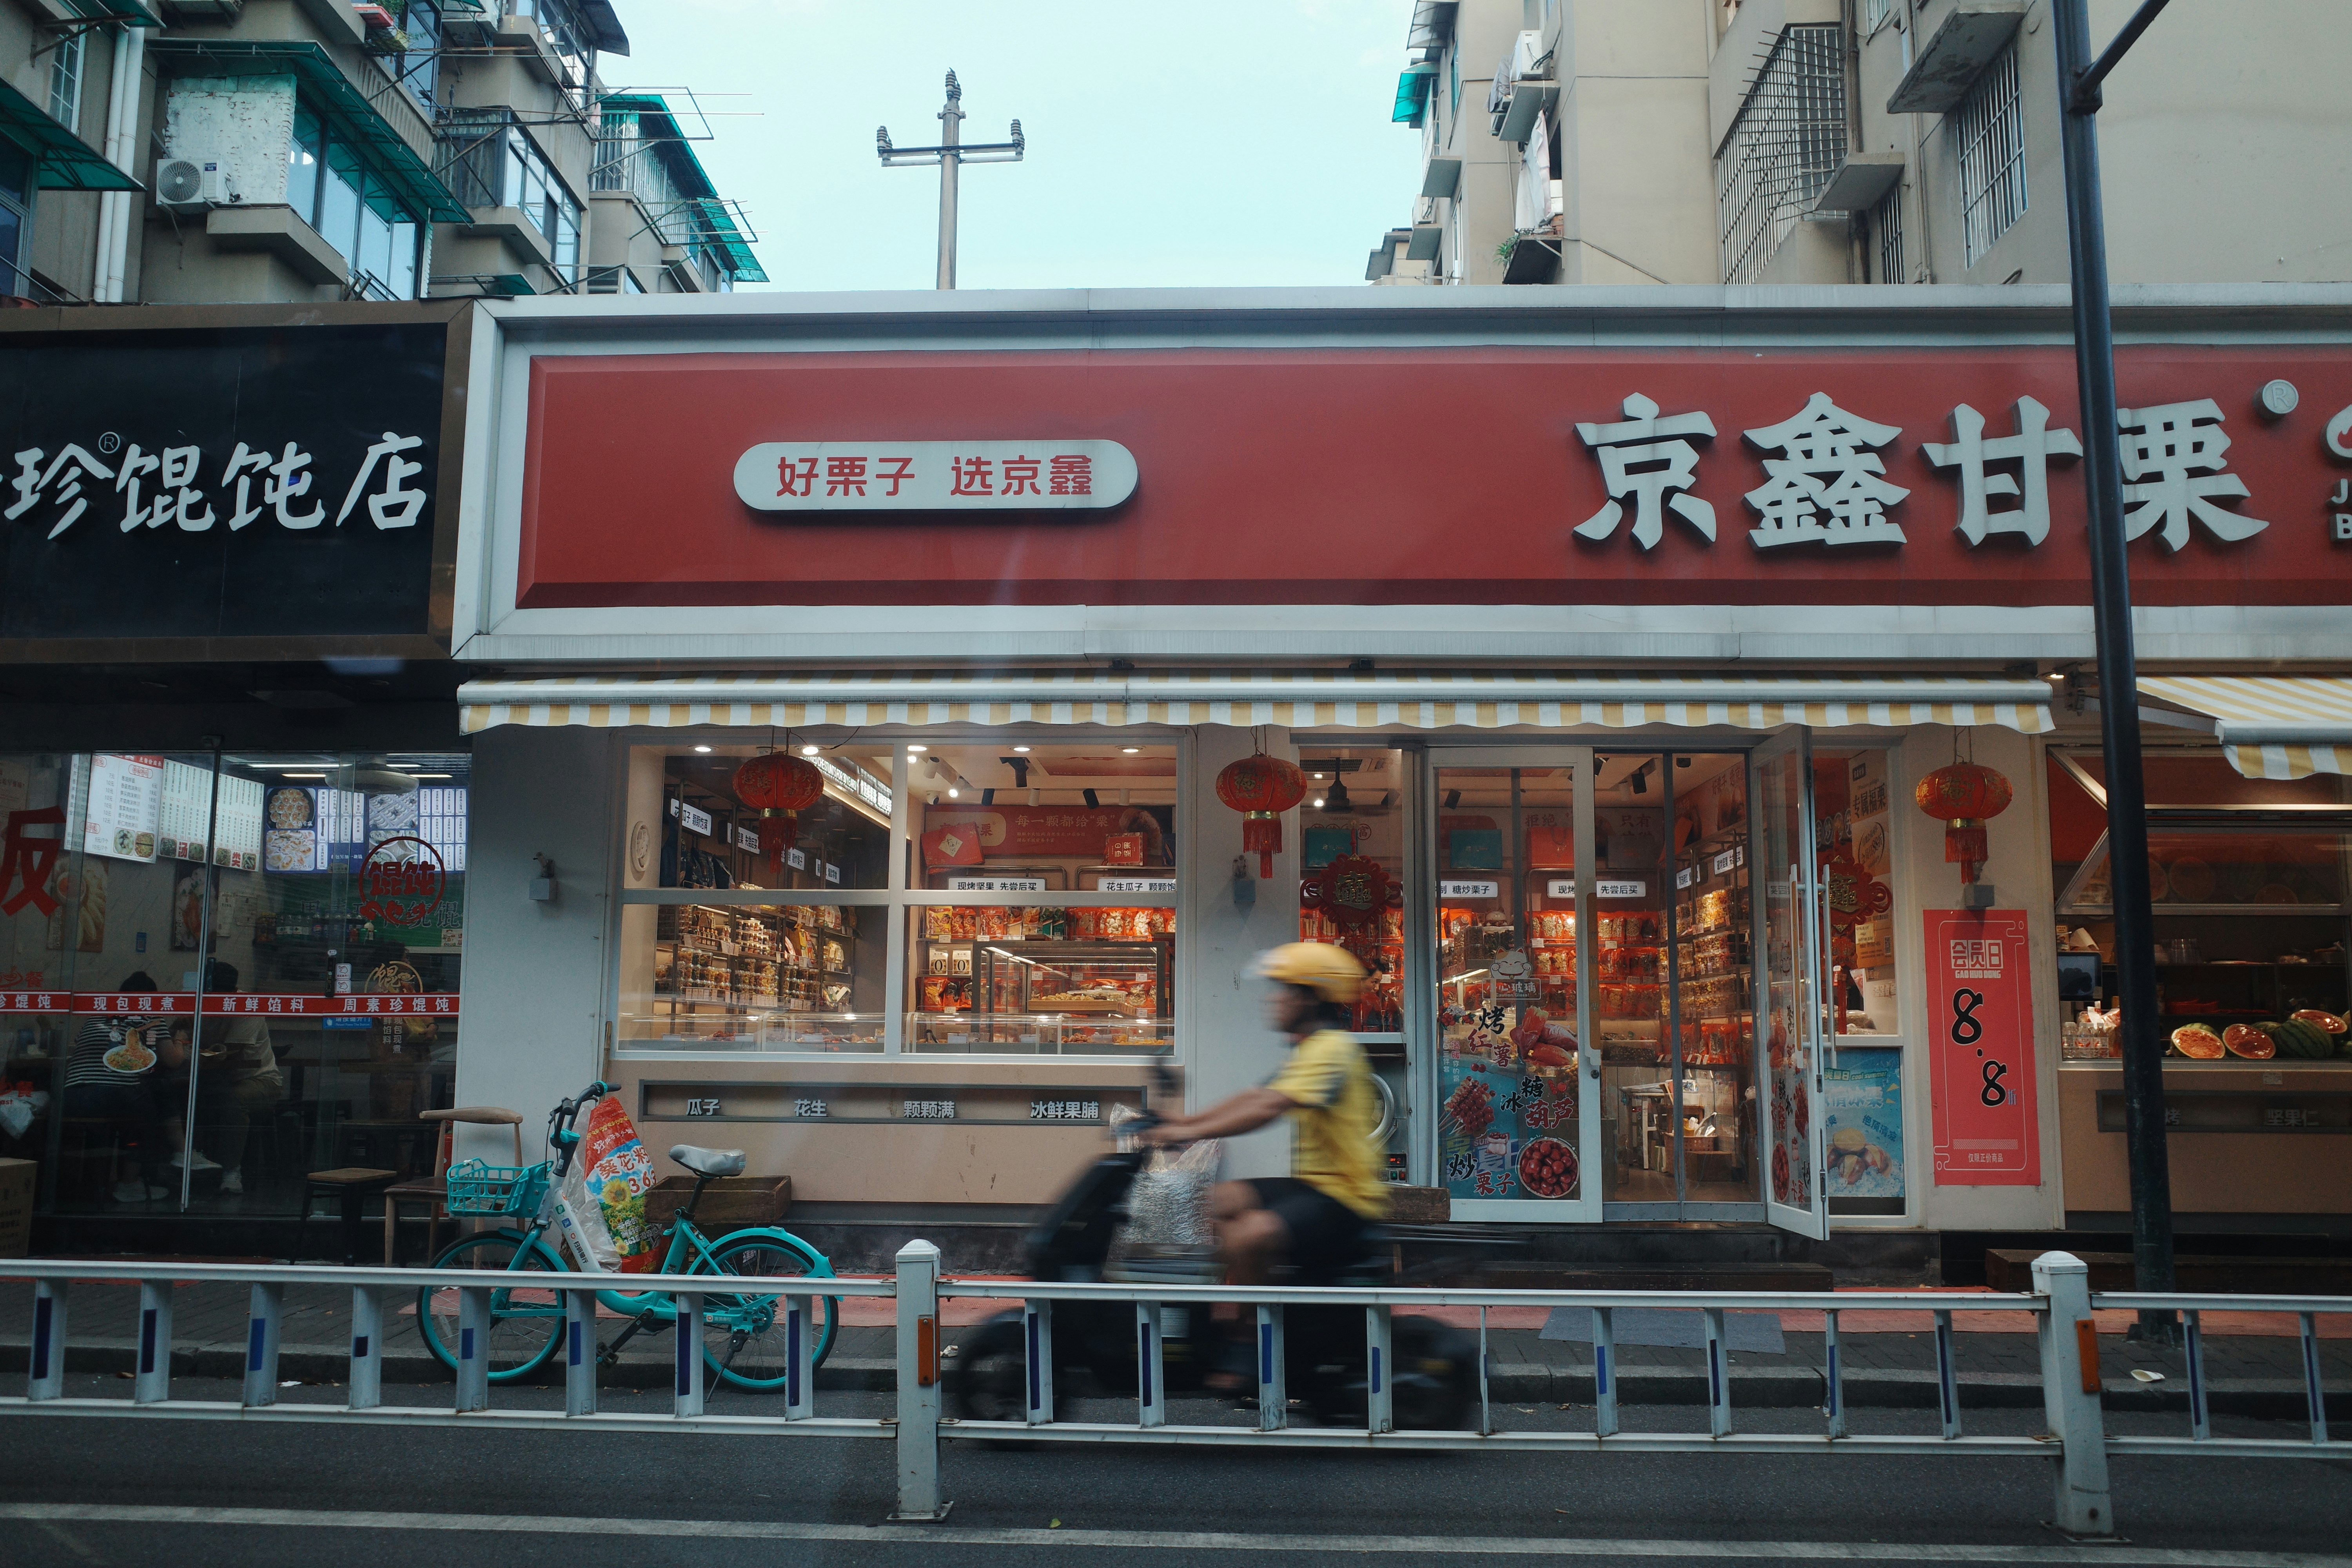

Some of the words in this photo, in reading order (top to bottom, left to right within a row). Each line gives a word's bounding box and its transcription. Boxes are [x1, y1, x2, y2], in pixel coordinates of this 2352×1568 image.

[777, 456, 915, 497] 好栗子
[951, 454, 1093, 497] 选京鑫
[1573, 392, 2270, 551] 京鑫甘栗
[0, 432, 426, 540] 珍馄饨店
[178, 841, 188, 858] 汤
[368, 861, 436, 896] 馄饨
[957, 882, 995, 891] 现烤坚果
[999, 882, 1037, 891] 先尝后买
[1106, 882, 1143, 891] 花生瓜子
[1452, 885, 1490, 895] 糖炒栗子
[1600, 885, 1638, 895] 先尝后买
[1951, 940, 2004, 969] 会员日
[93, 997, 175, 1011] 现包现煮
[222, 997, 304, 1012] 新鲜馅料
[343, 998, 450, 1012] 周素珍馄饨
[686, 1098, 720, 1116] 瓜子
[794, 1099, 827, 1117] 花生
[903, 1101, 955, 1118] 颗颗满
[1030, 1101, 1099, 1119] 冰鲜果脯
[2266, 1109, 2319, 1127] 坚果仁
[1968, 1153, 2003, 1162] 仅限正价商品
[573, 1240, 589, 1264] 扫码骑行
